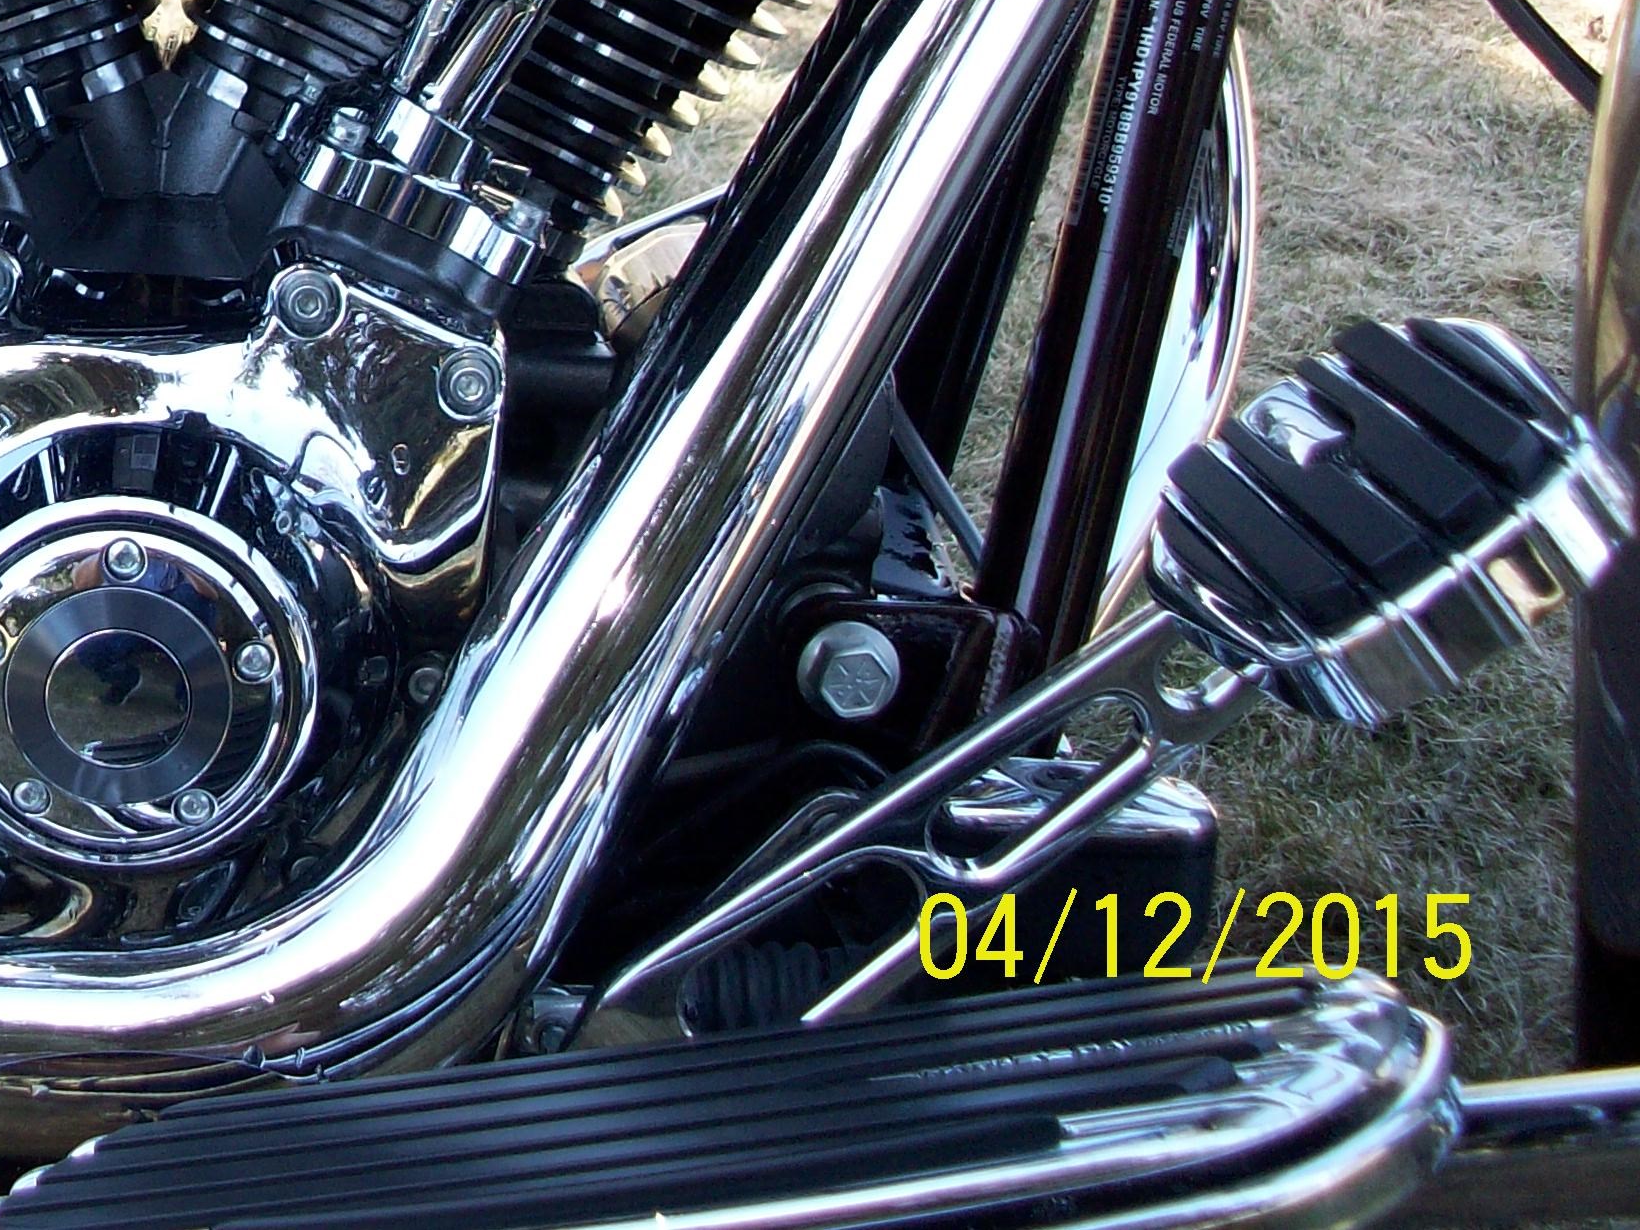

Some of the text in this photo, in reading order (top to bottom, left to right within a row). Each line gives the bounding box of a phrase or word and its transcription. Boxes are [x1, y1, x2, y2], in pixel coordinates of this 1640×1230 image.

[1175, 1, 1185, 15] US
[1160, 19, 1181, 70] FEDERAL
[1192, 26, 1205, 51] TIRE
[1148, 74, 1166, 114] MOTOR
[1091, 111, 1117, 189] MOTORCYCLE
